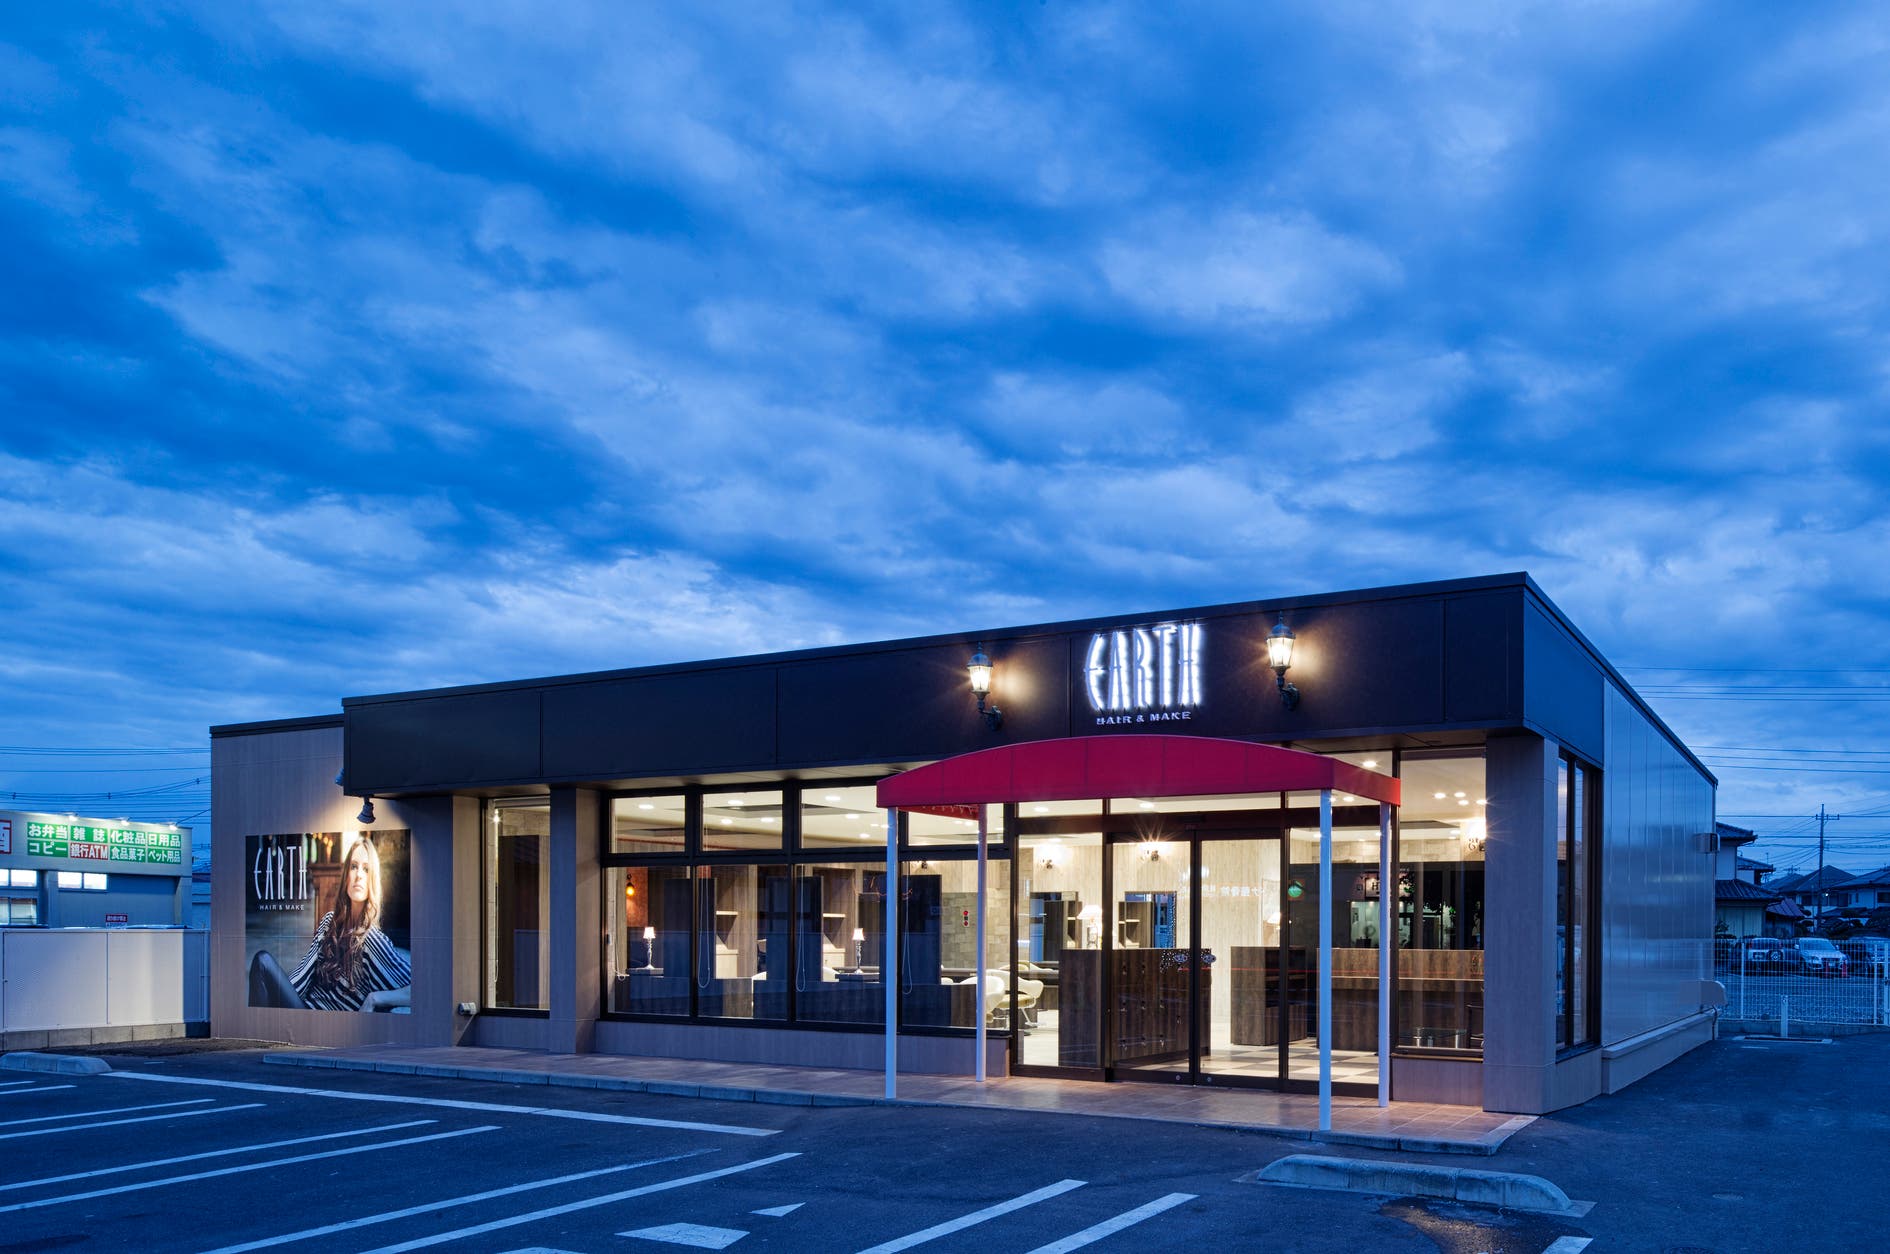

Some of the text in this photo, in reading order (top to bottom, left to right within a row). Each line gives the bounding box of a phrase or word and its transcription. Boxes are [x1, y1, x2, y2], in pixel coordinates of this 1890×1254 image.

[1083, 623, 1200, 710] EARTH
[1096, 711, 1192, 725] HAIR & MAKE
[29, 824, 68, 840] お弁当
[111, 831, 146, 845] 化粧品
[149, 834, 181, 847] 日用品
[29, 841, 67, 855] コピー
[71, 844, 108, 859] 銀行ATM
[149, 850, 181, 863] ペット用品
[254, 846, 307, 900] EARTH
